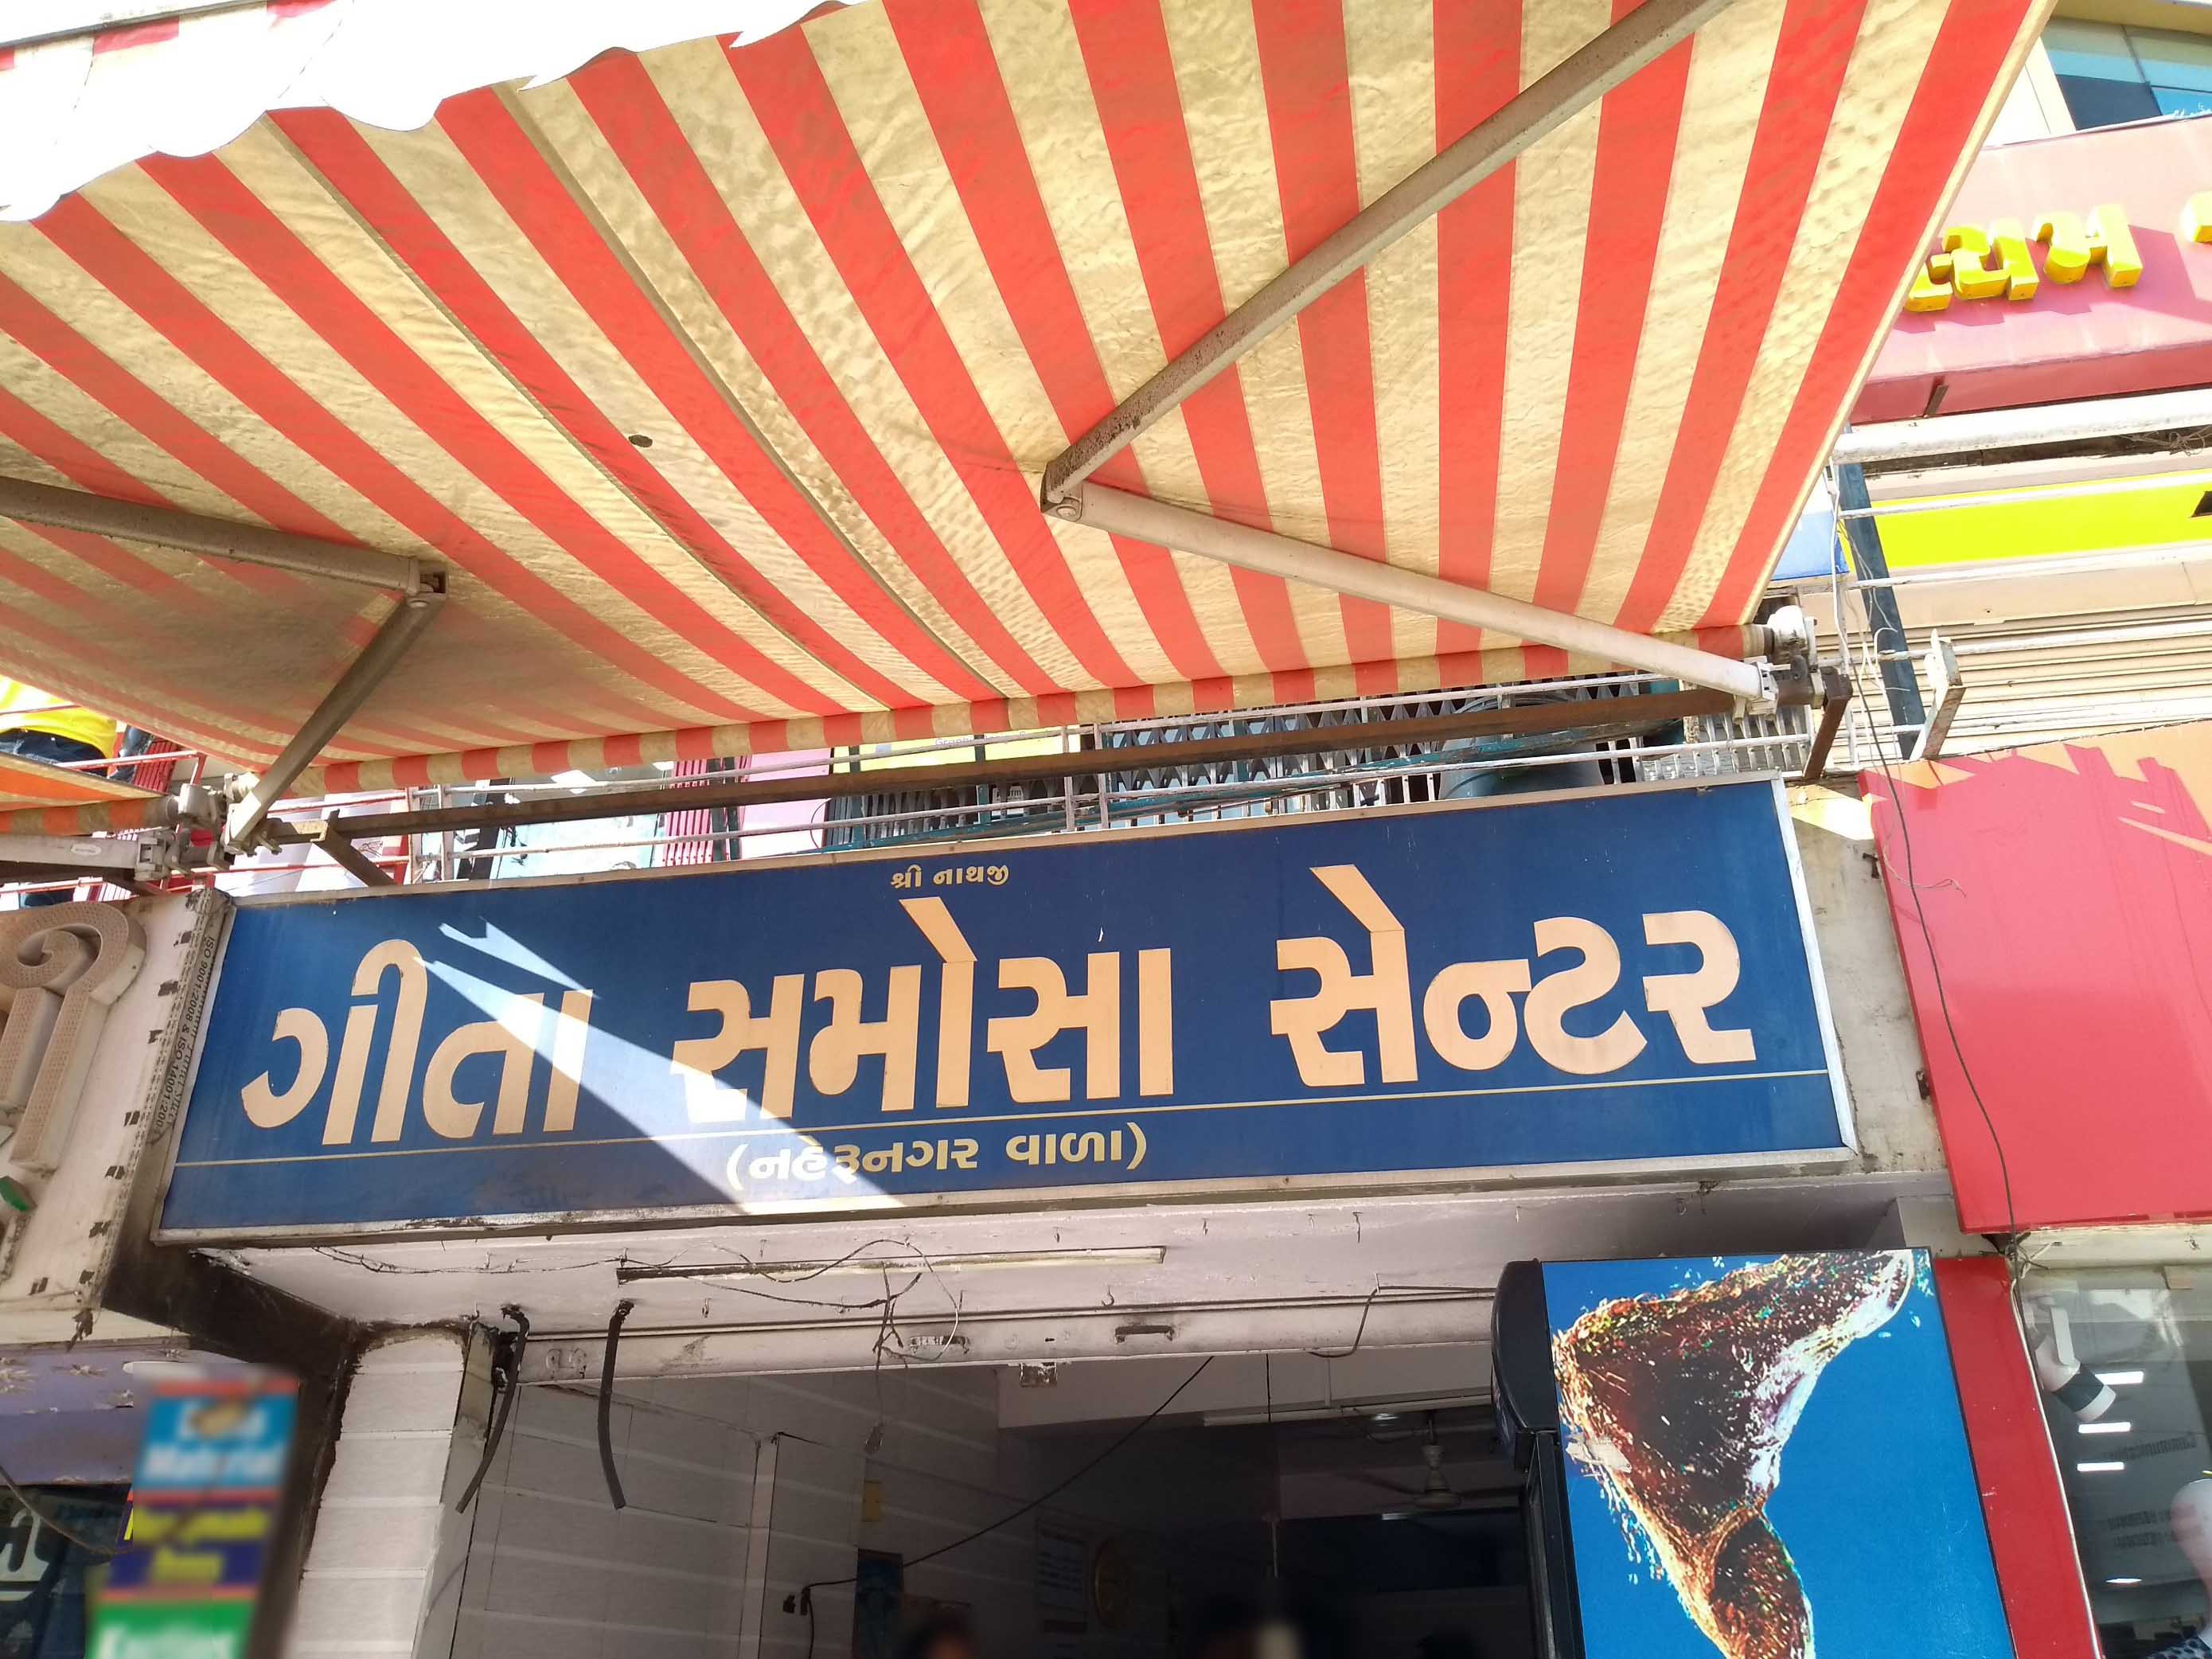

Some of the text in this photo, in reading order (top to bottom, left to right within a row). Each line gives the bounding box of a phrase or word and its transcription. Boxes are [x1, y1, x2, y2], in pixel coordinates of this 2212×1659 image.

[891, 864, 1009, 889] શ્રી નાથજી
[204, 936, 216, 958] ISO
[185, 961, 208, 1023] 9001:2008
[241, 939, 593, 1145] ગીતા
[670, 896, 1174, 1123] સમોસા
[1270, 864, 1756, 1087] સેન્ટર
[175, 1036, 187, 1060] ISO
[1006, 1122, 1147, 1170] વાળા)
